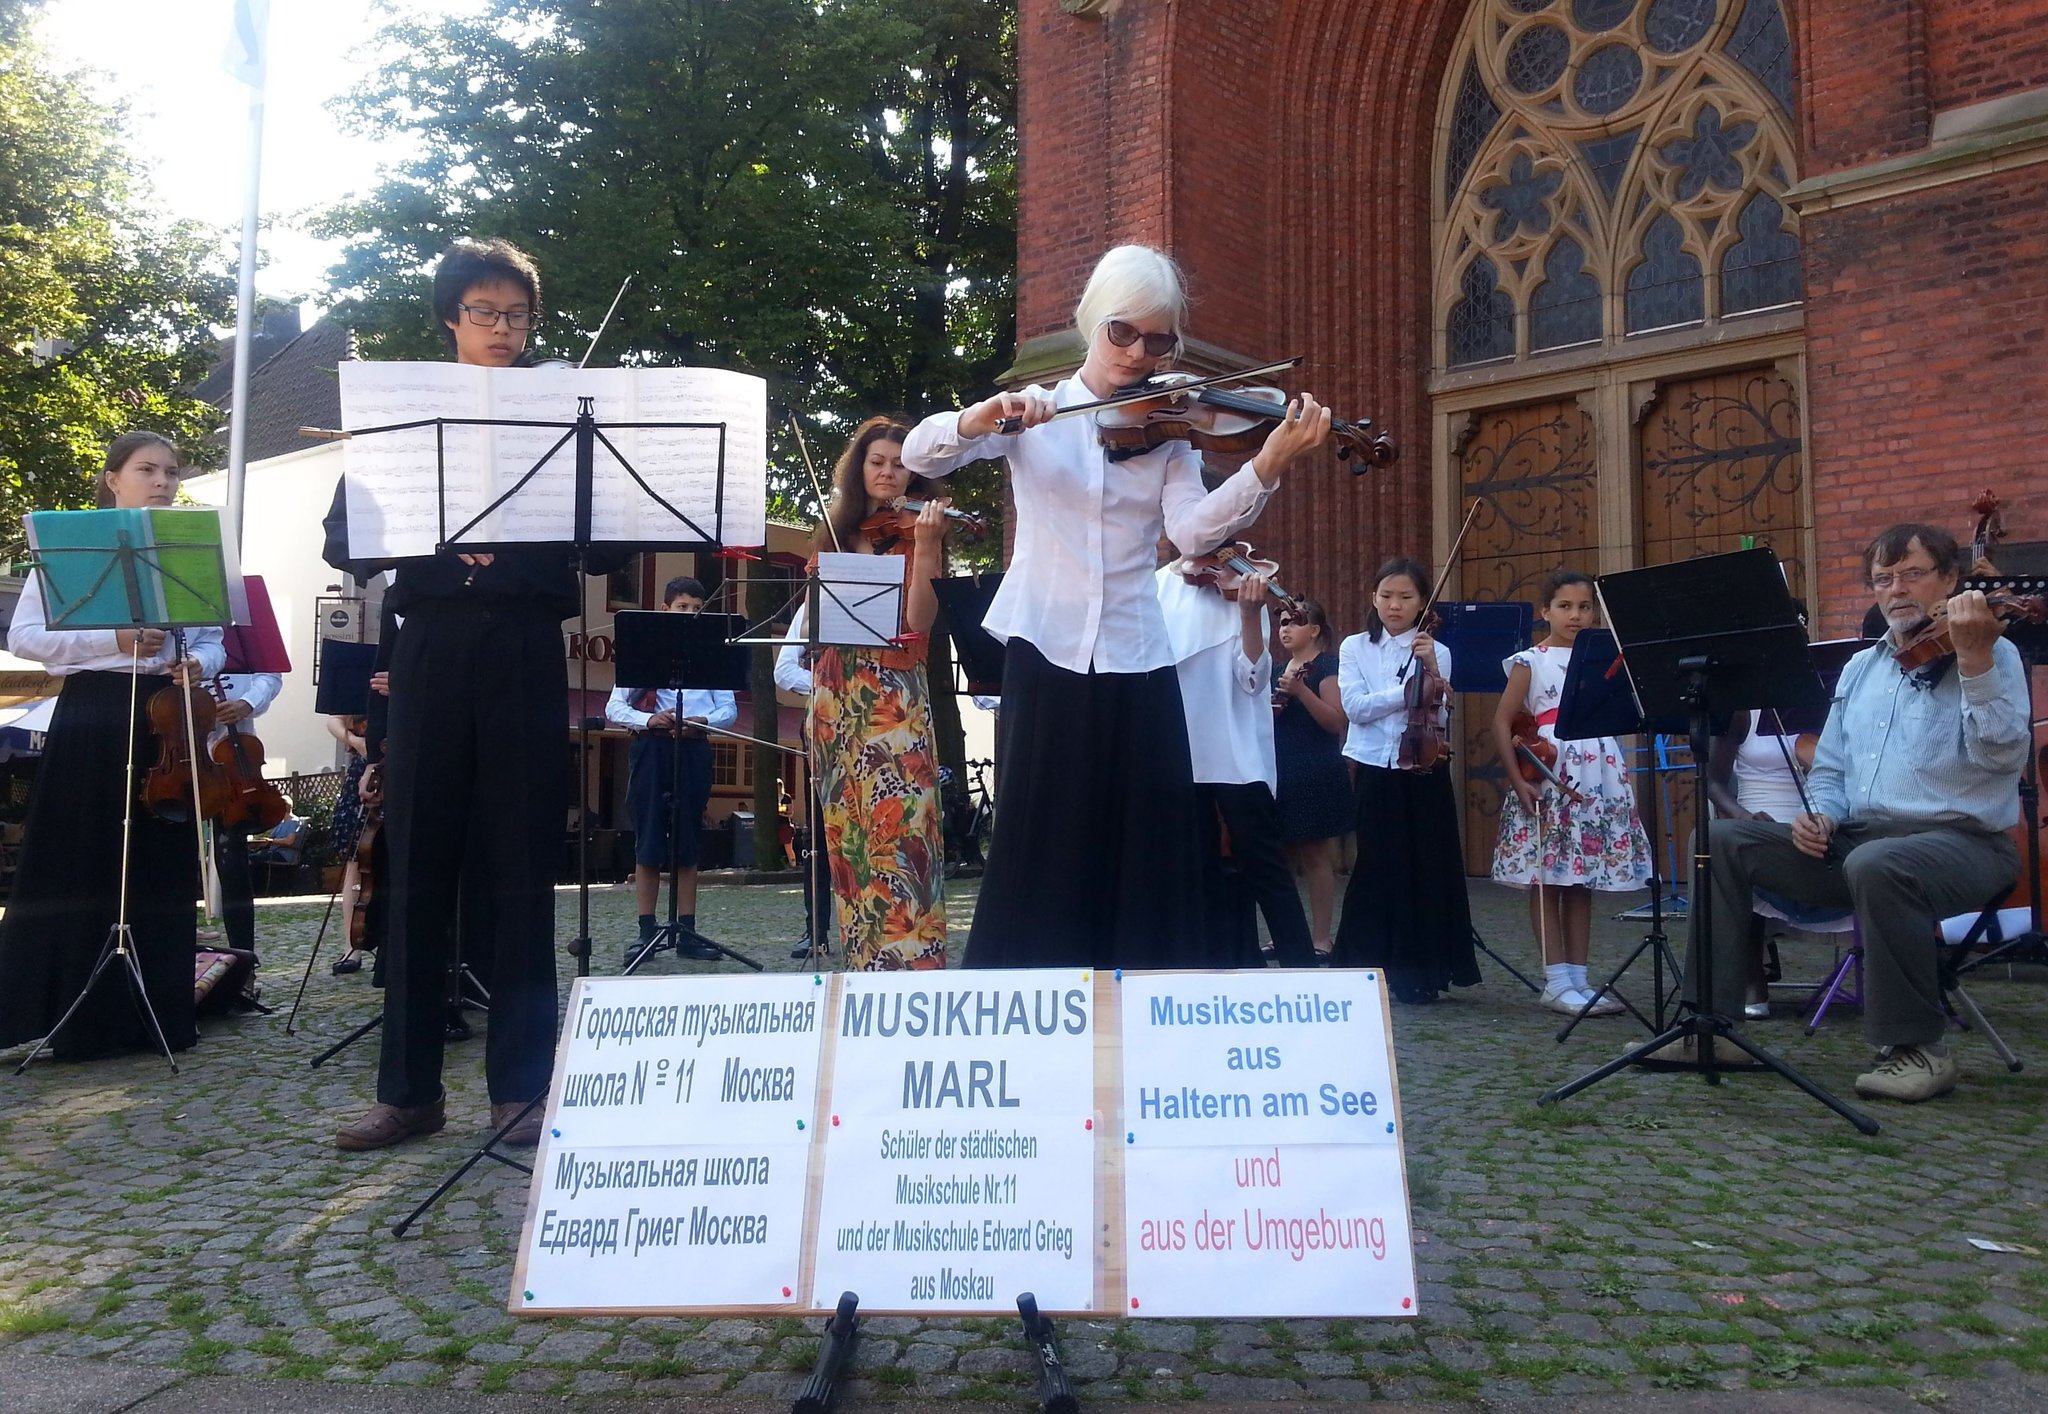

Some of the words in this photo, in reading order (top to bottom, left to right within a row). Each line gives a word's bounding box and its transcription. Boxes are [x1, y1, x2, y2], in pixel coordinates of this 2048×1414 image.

[566, 631, 616, 662] RO
[575, 997, 678, 1049] Городская
[842, 989, 1087, 1038] MUSIKHAUS
[1150, 993, 1352, 1026] Musikschüler
[1227, 1045, 1281, 1070] aus
[563, 1071, 627, 1107] школа
[676, 1058, 696, 1104] 11
[720, 1057, 795, 1103] Москва
[902, 1060, 1020, 1109] MARL
[1140, 1087, 1251, 1119] Haltern
[1262, 1092, 1309, 1117] am
[1319, 1083, 1378, 1116] See
[881, 1129, 932, 1160] Schüler
[935, 1129, 957, 1159] der
[960, 1129, 1037, 1159] städtischen
[555, 1152, 698, 1199] Музыкальная
[703, 1155, 770, 1188] школа
[1235, 1147, 1281, 1188] und
[895, 1174, 980, 1205] Musikschule
[539, 1209, 620, 1258] Едвард
[623, 1207, 685, 1257] Гриег
[689, 1206, 768, 1246] Москва
[837, 1220, 864, 1251] und
[867, 1220, 890, 1251] der
[893, 1220, 979, 1251] Musikschule
[982, 1219, 1031, 1251] Edvard
[1035, 1219, 1073, 1260] Grieg
[1140, 1217, 1186, 1251] aus
[1194, 1208, 1236, 1251] der
[1244, 1208, 1386, 1262] Umgebung
[910, 1275, 936, 1300] aus
[940, 1267, 994, 1301] Moskau
